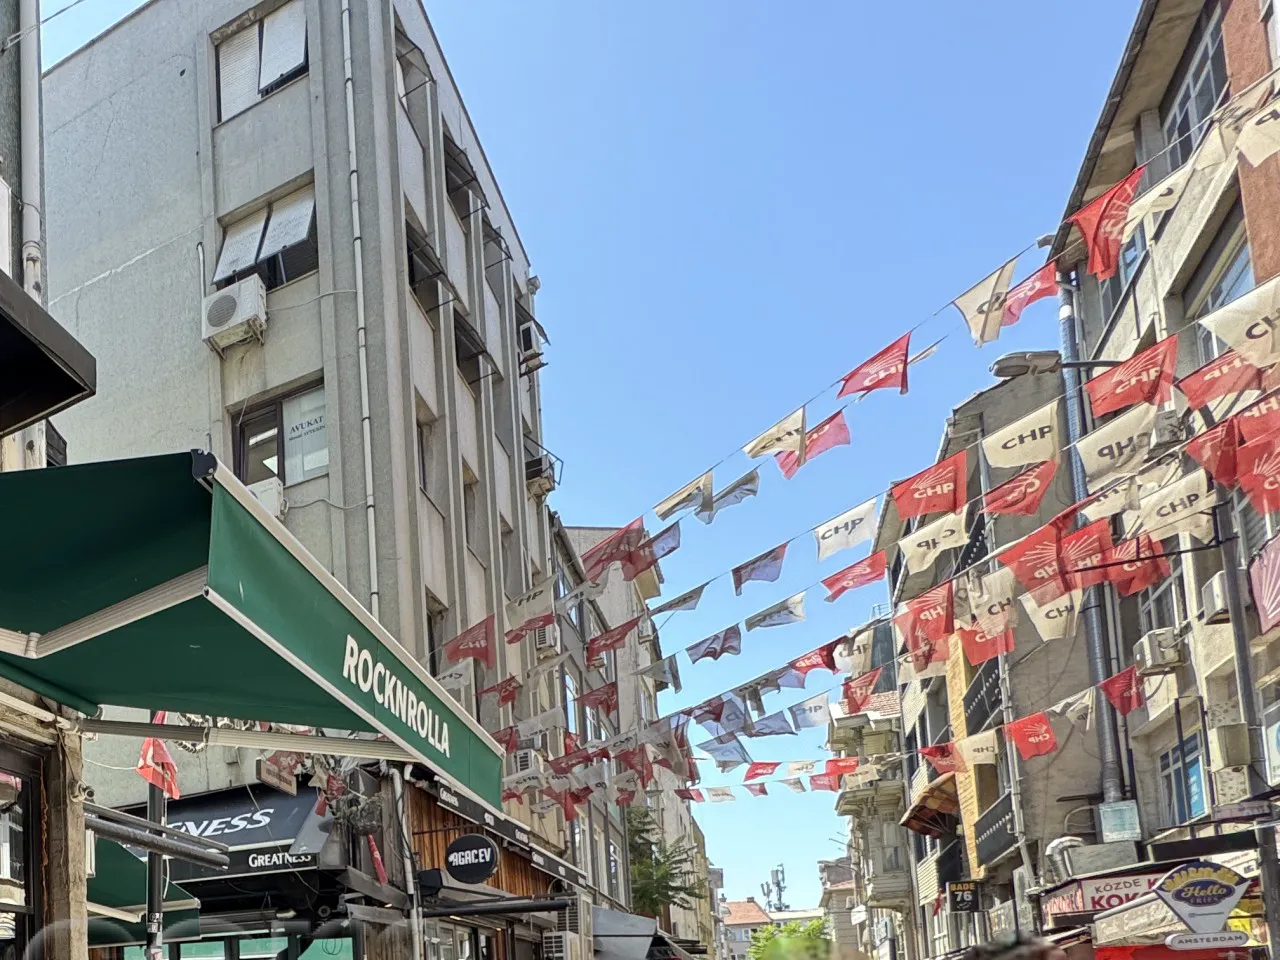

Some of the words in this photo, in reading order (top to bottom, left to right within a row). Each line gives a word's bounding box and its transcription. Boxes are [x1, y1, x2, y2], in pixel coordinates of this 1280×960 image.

[1115, 367, 1161, 394] CHP
[1001, 425, 1054, 450] CHP
[913, 483, 954, 499] CHP
[1156, 493, 1199, 518] CHP
[820, 517, 864, 541] CHP
[342, 633, 452, 759] ROCKNROLLA
[1095, 878, 1141, 894] KÖZDE
[1181, 884, 1227, 897] Hello
[955, 892, 972, 902] 76
[1178, 935, 1243, 945] AMSTERDAM
